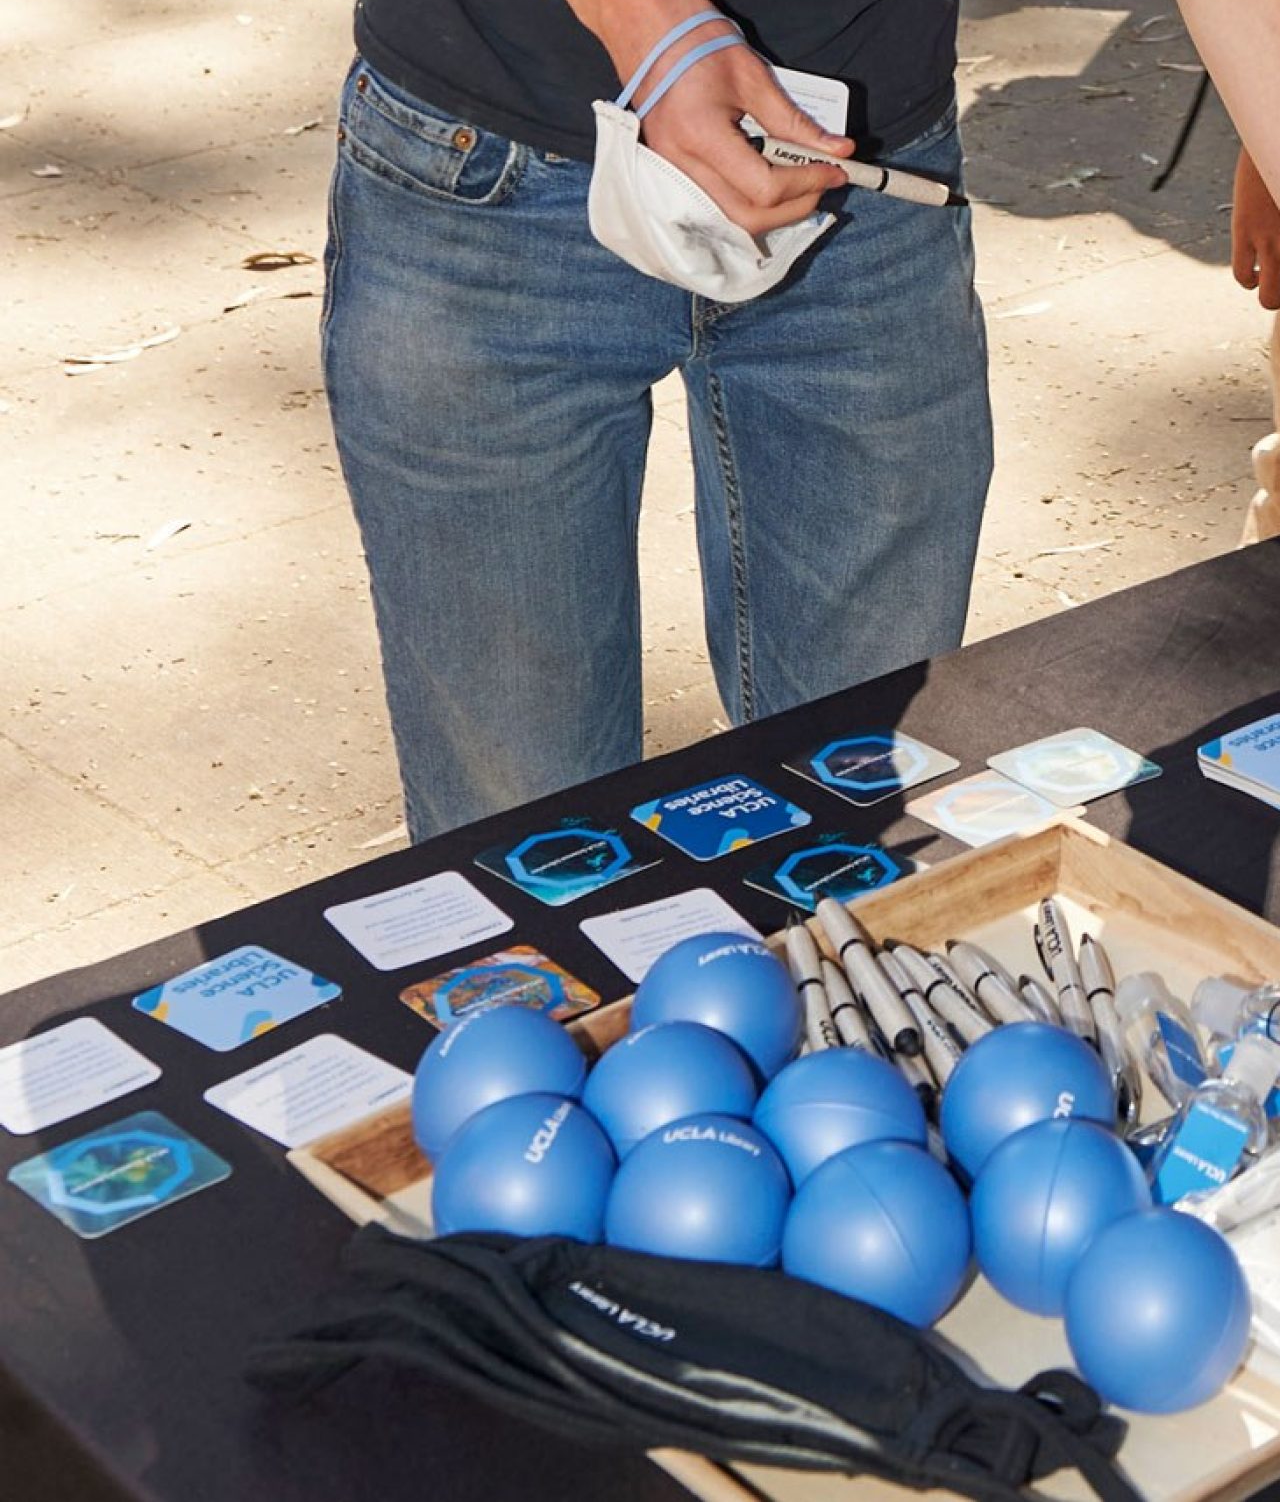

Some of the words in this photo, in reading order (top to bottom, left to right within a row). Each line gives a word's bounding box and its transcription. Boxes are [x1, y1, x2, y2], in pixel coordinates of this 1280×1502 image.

[663, 779, 749, 811] Libraries
[687, 787, 763, 816] Science
[717, 795, 777, 819] UCLA
[172, 950, 264, 994] Libraries
[199, 959, 281, 998] Science
[236, 968, 299, 997] UCLA
[524, 1115, 559, 1163] UCLA
[662, 1125, 716, 1144] UCLA
[1198, 1158, 1227, 1185] UCLA
[617, 1308, 677, 1342] UCLA
